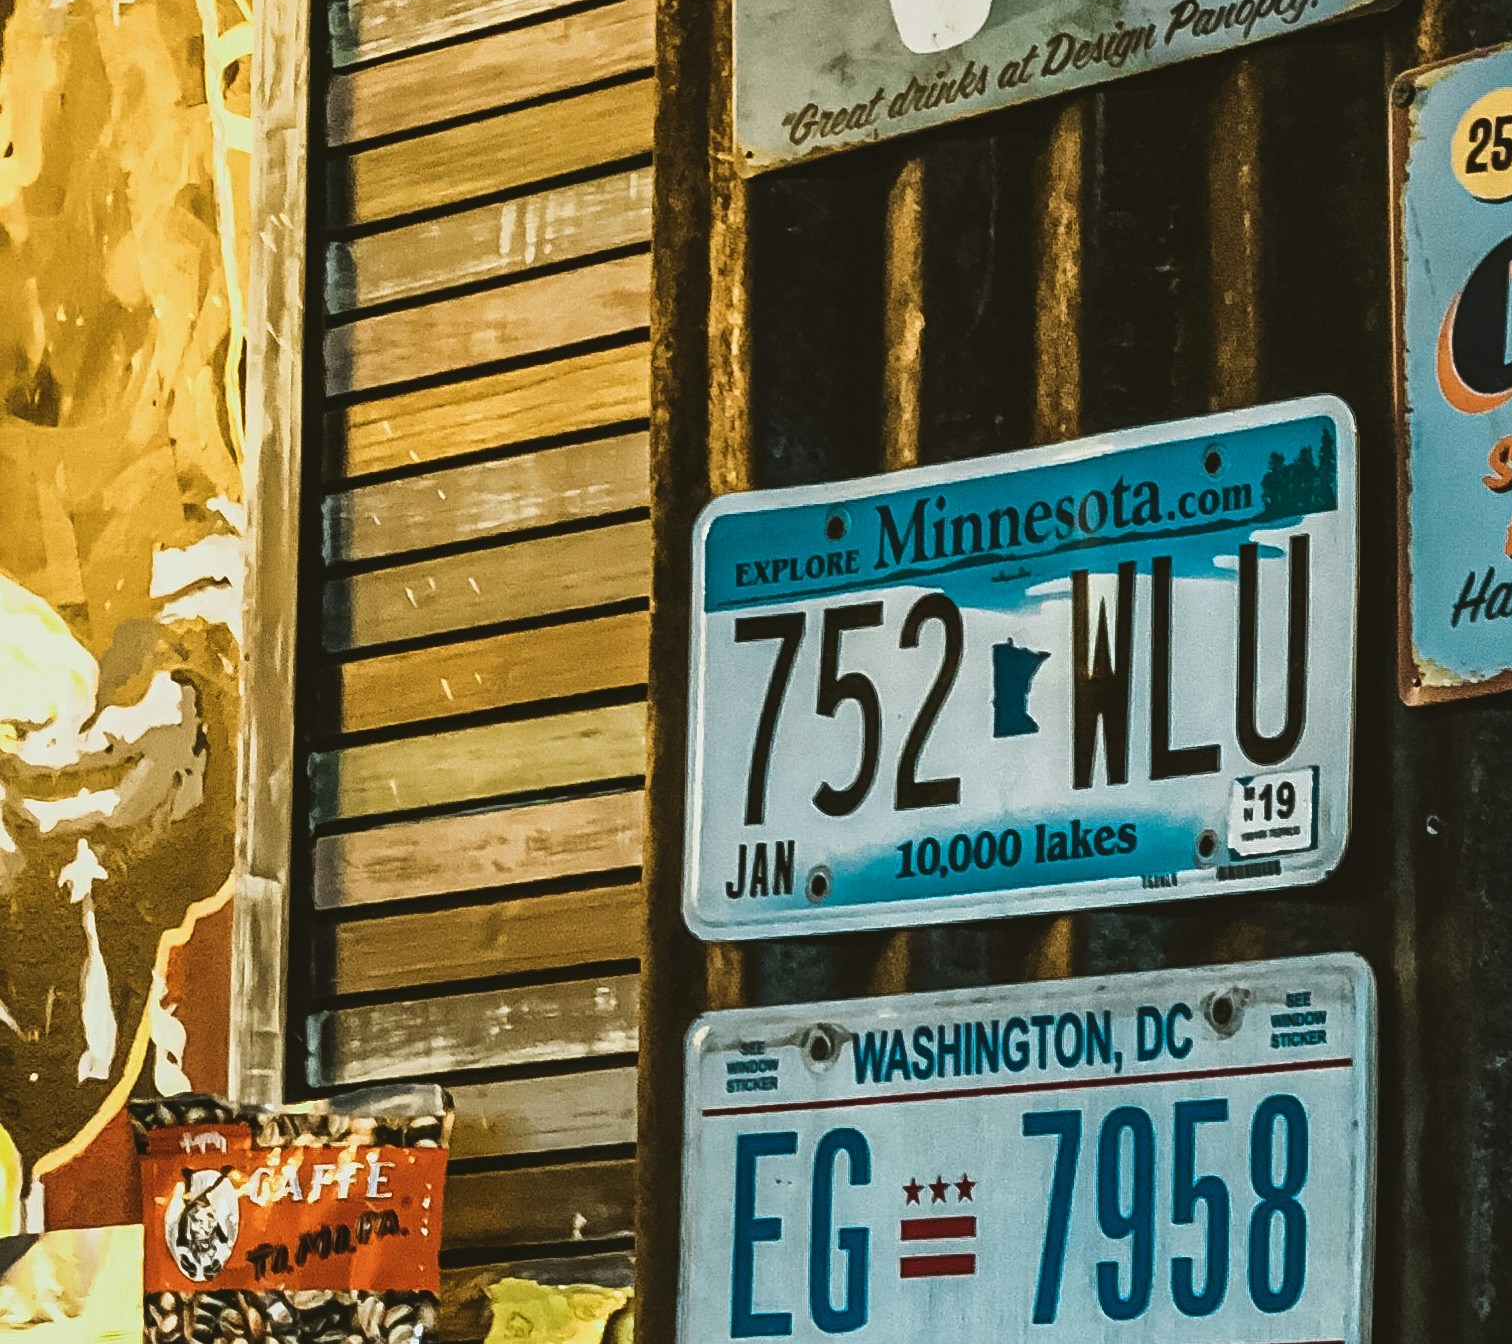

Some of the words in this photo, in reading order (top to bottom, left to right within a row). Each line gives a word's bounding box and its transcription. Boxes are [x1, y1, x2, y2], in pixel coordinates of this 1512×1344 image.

[889, 62, 988, 119] drinks
[997, 52, 1041, 92] at
[1041, 23, 1156, 80] Design
[735, 548, 861, 588] EXPLORE
[874, 475, 1254, 569] Minnesota.com
[733, 593, 965, 827] 752
[1071, 532, 1312, 790] WLU
[1258, 780, 1296, 821] 19
[725, 840, 796, 900] JAN
[895, 828, 1022, 880] 10,000
[1034, 818, 1139, 865] lakes
[852, 1010, 1122, 1085] WASHINGTON,
[1137, 1002, 1193, 1062] DC
[1270, 1009, 1327, 1028] WINDOW
[1270, 1029, 1328, 1049] STICKER
[727, 1058, 779, 1076] WINDOW
[727, 1076, 779, 1094] STICKER
[730, 1127, 872, 1340] EG
[1021, 1093, 1311, 1325] 7958
